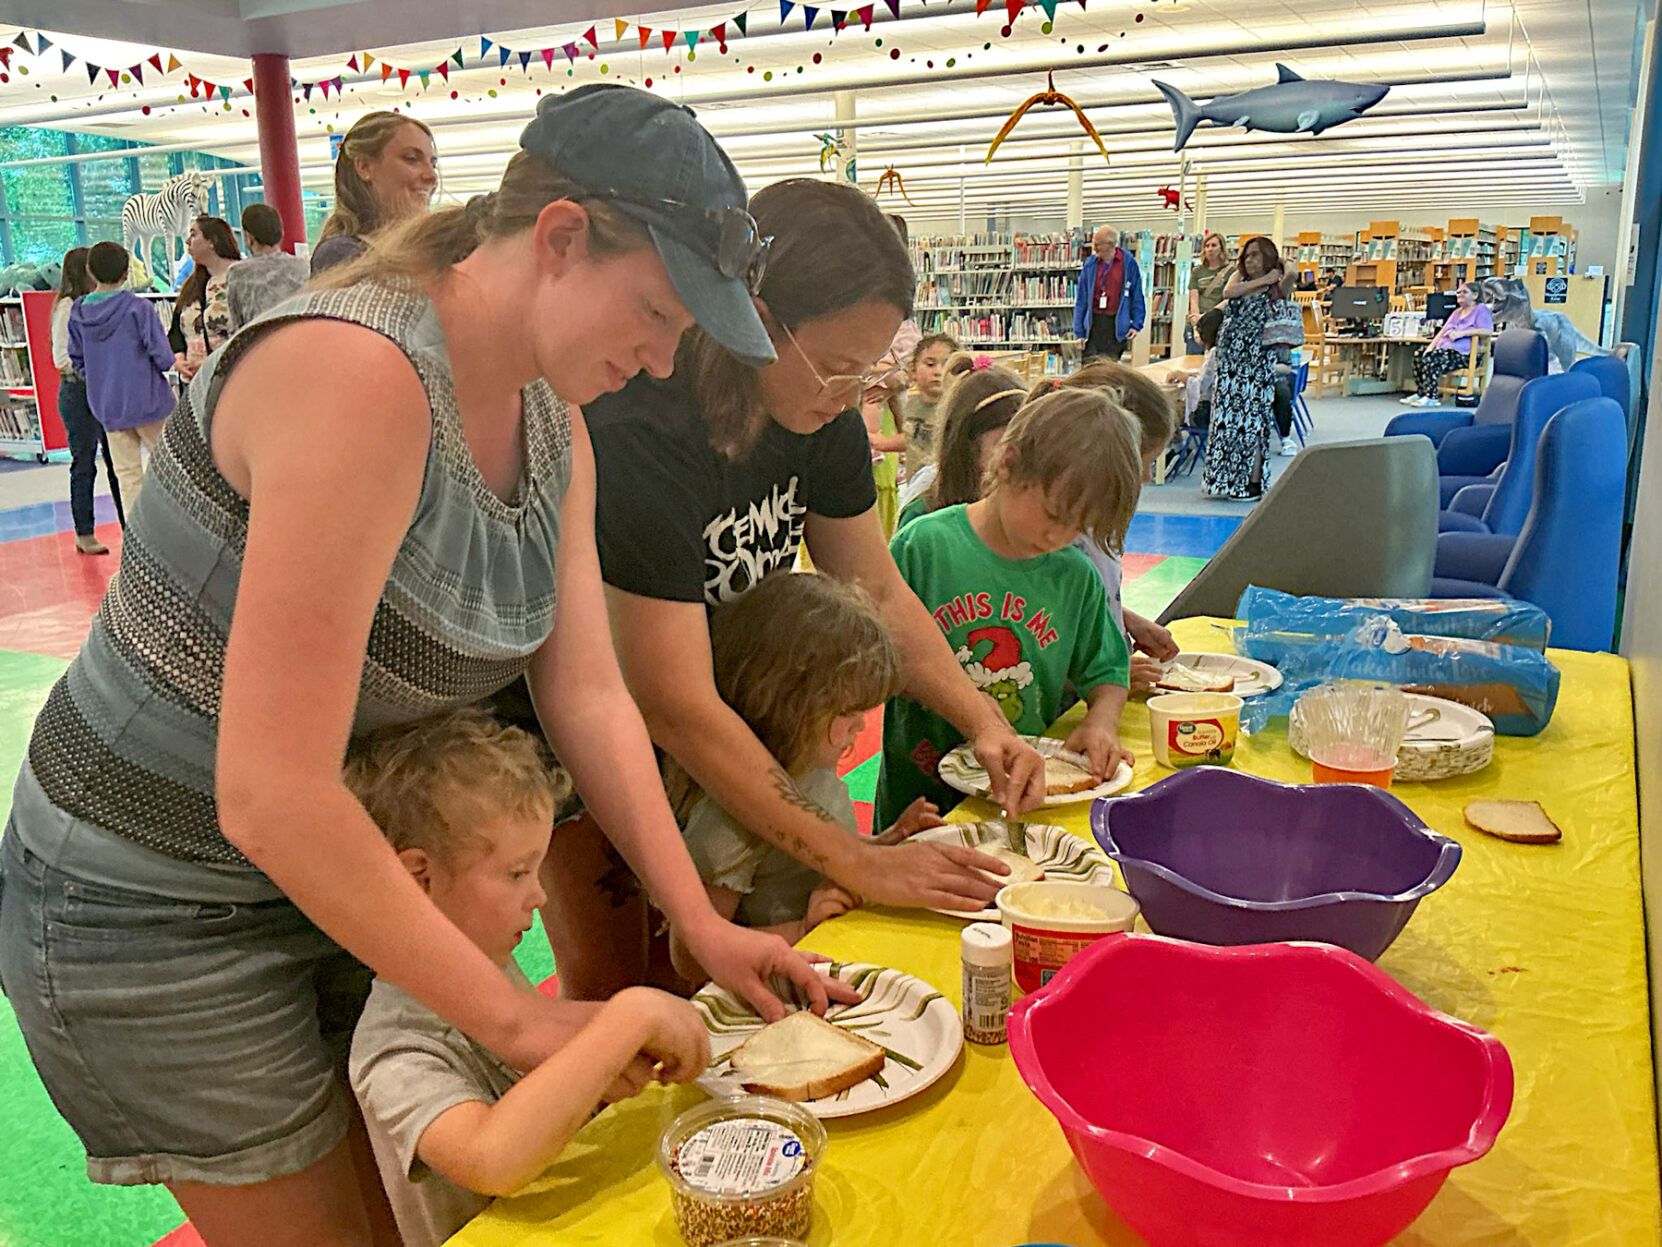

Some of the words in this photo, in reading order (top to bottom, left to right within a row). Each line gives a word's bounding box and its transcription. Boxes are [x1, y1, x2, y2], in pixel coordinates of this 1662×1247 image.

[934, 591, 993, 632] THIS
[1001, 591, 1026, 623] IS
[1026, 608, 1060, 649] ME
[1183, 740, 1207, 748] Canola
